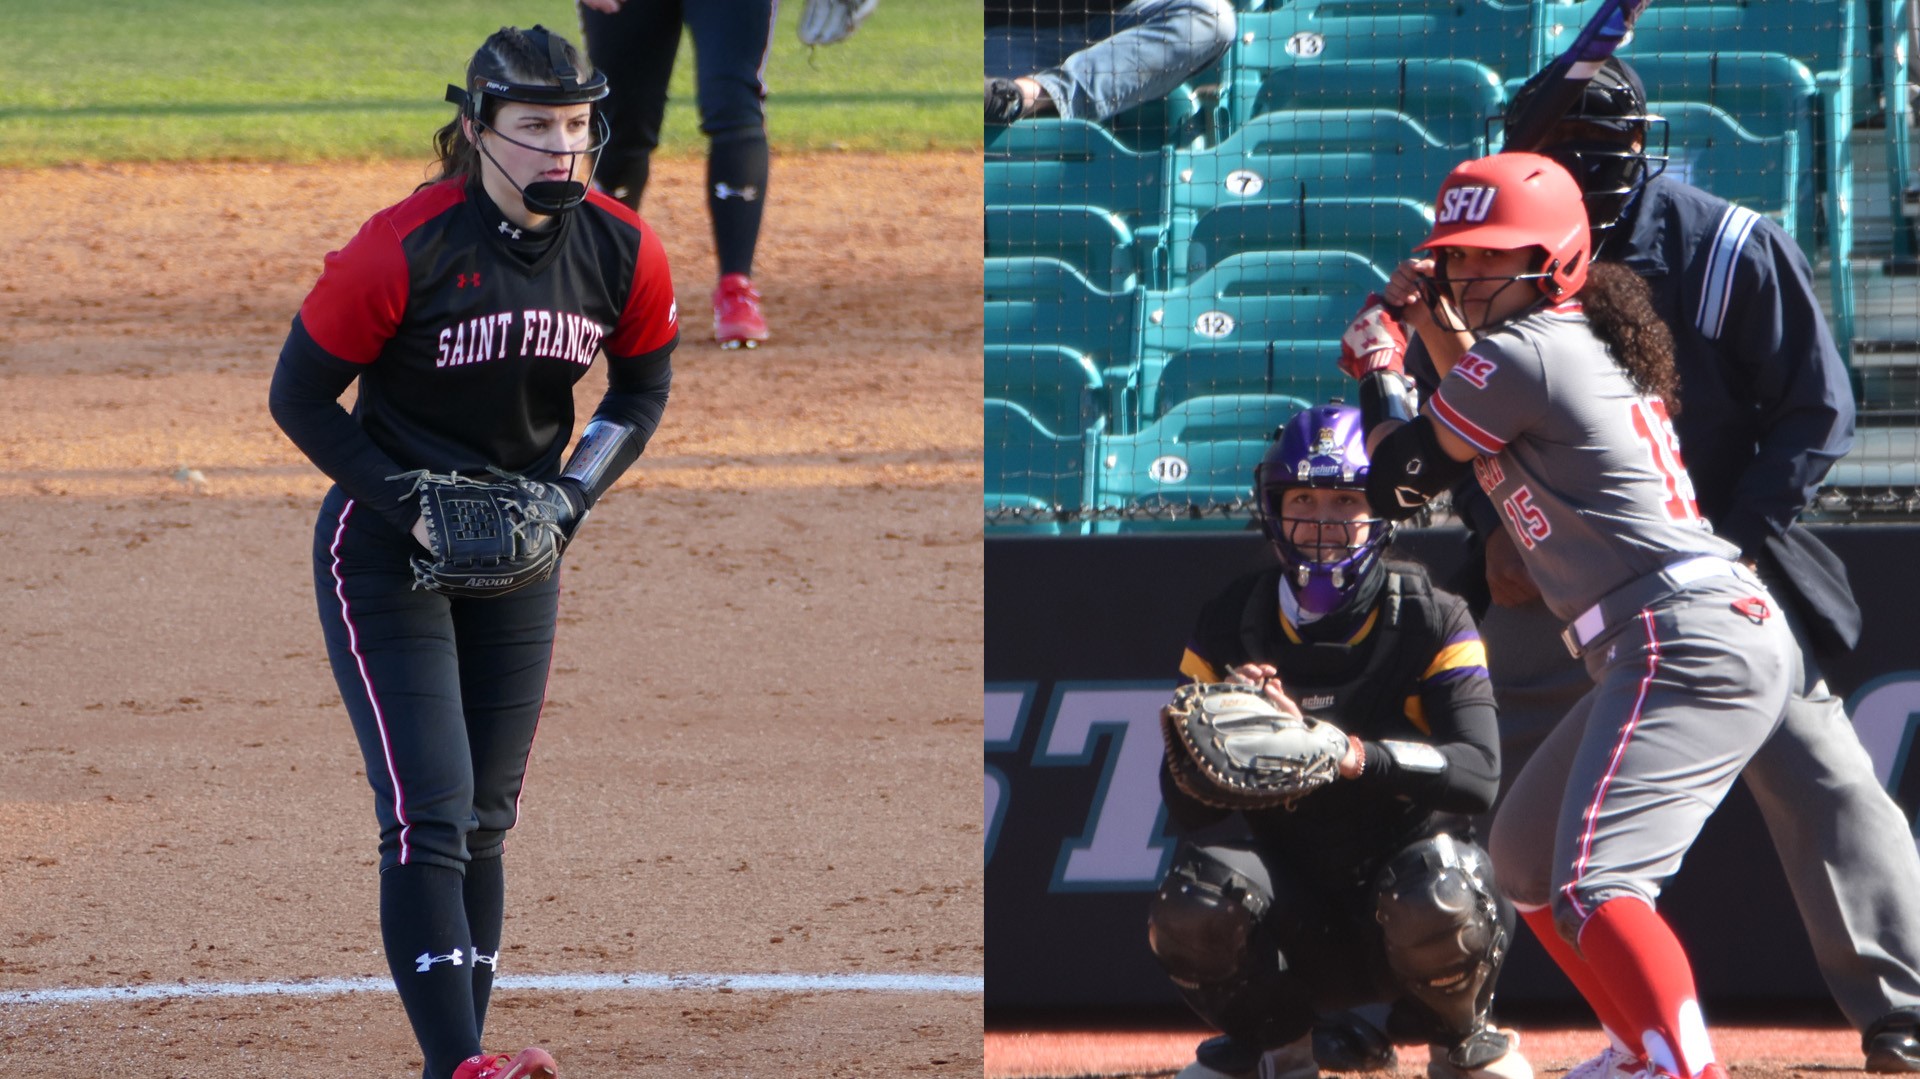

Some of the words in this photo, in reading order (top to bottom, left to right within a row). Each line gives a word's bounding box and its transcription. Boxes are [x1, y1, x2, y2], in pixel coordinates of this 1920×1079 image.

[1292, 36, 1318, 54] 13
[1236, 176, 1252, 193] 7
[1439, 186, 1497, 223] SFU
[1203, 316, 1225, 333] 12
[436, 312, 512, 368] SAINT
[1159, 461, 1181, 478] 10
[1503, 484, 1551, 551] 15
[465, 577, 514, 587] A2000
[1302, 695, 1335, 710] schutt
